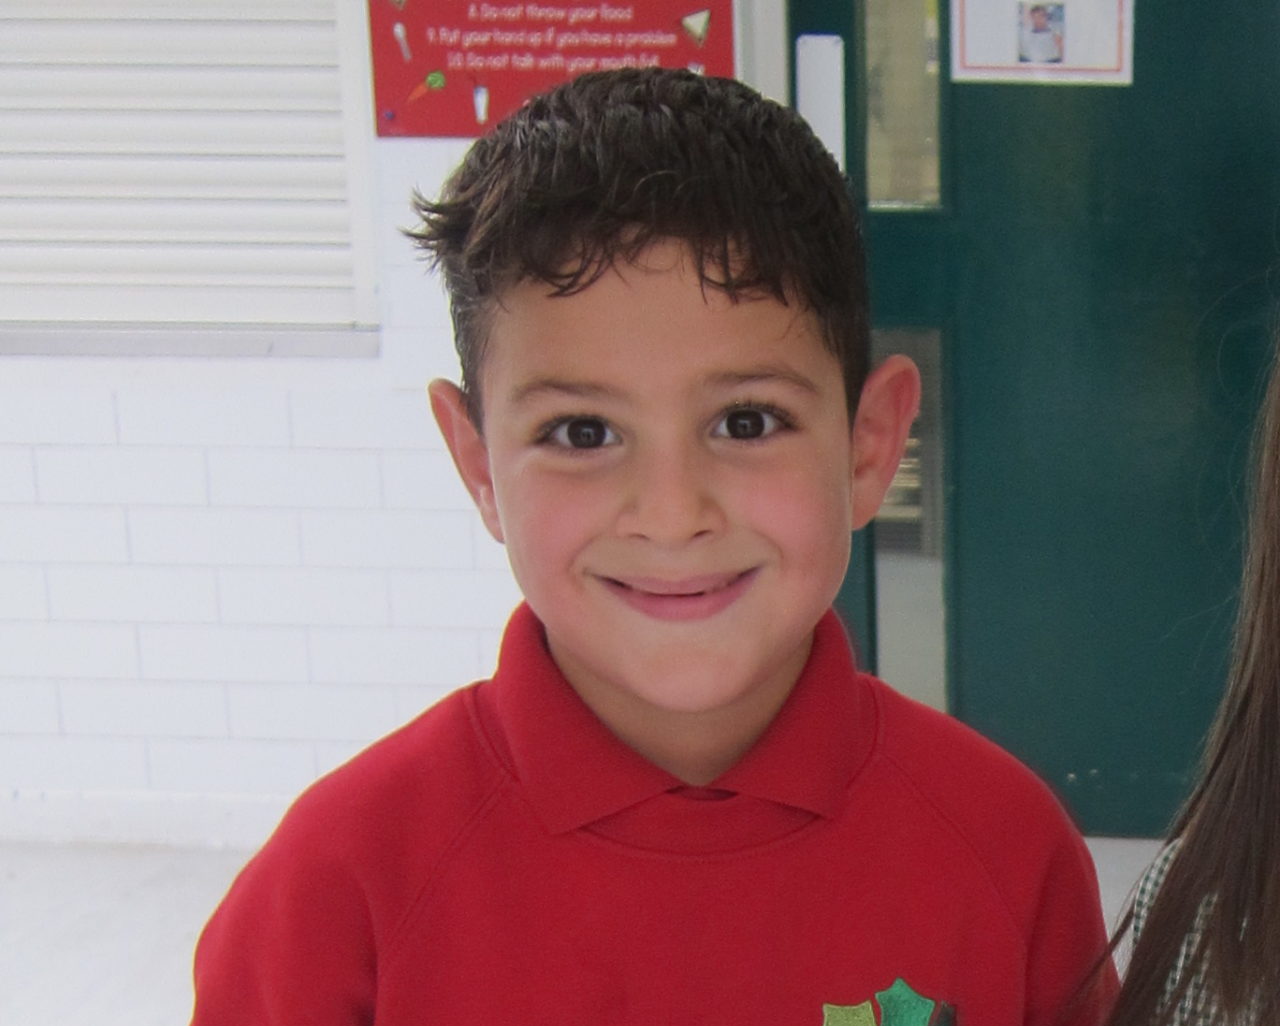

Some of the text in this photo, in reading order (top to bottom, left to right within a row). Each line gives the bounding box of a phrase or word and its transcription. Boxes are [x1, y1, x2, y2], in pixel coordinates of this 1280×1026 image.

[499, 4, 523, 21] not
[568, 7, 597, 25] your
[599, 3, 633, 22] food
[462, 31, 492, 49] your
[486, 53, 509, 70] not
[567, 57, 597, 73] your
